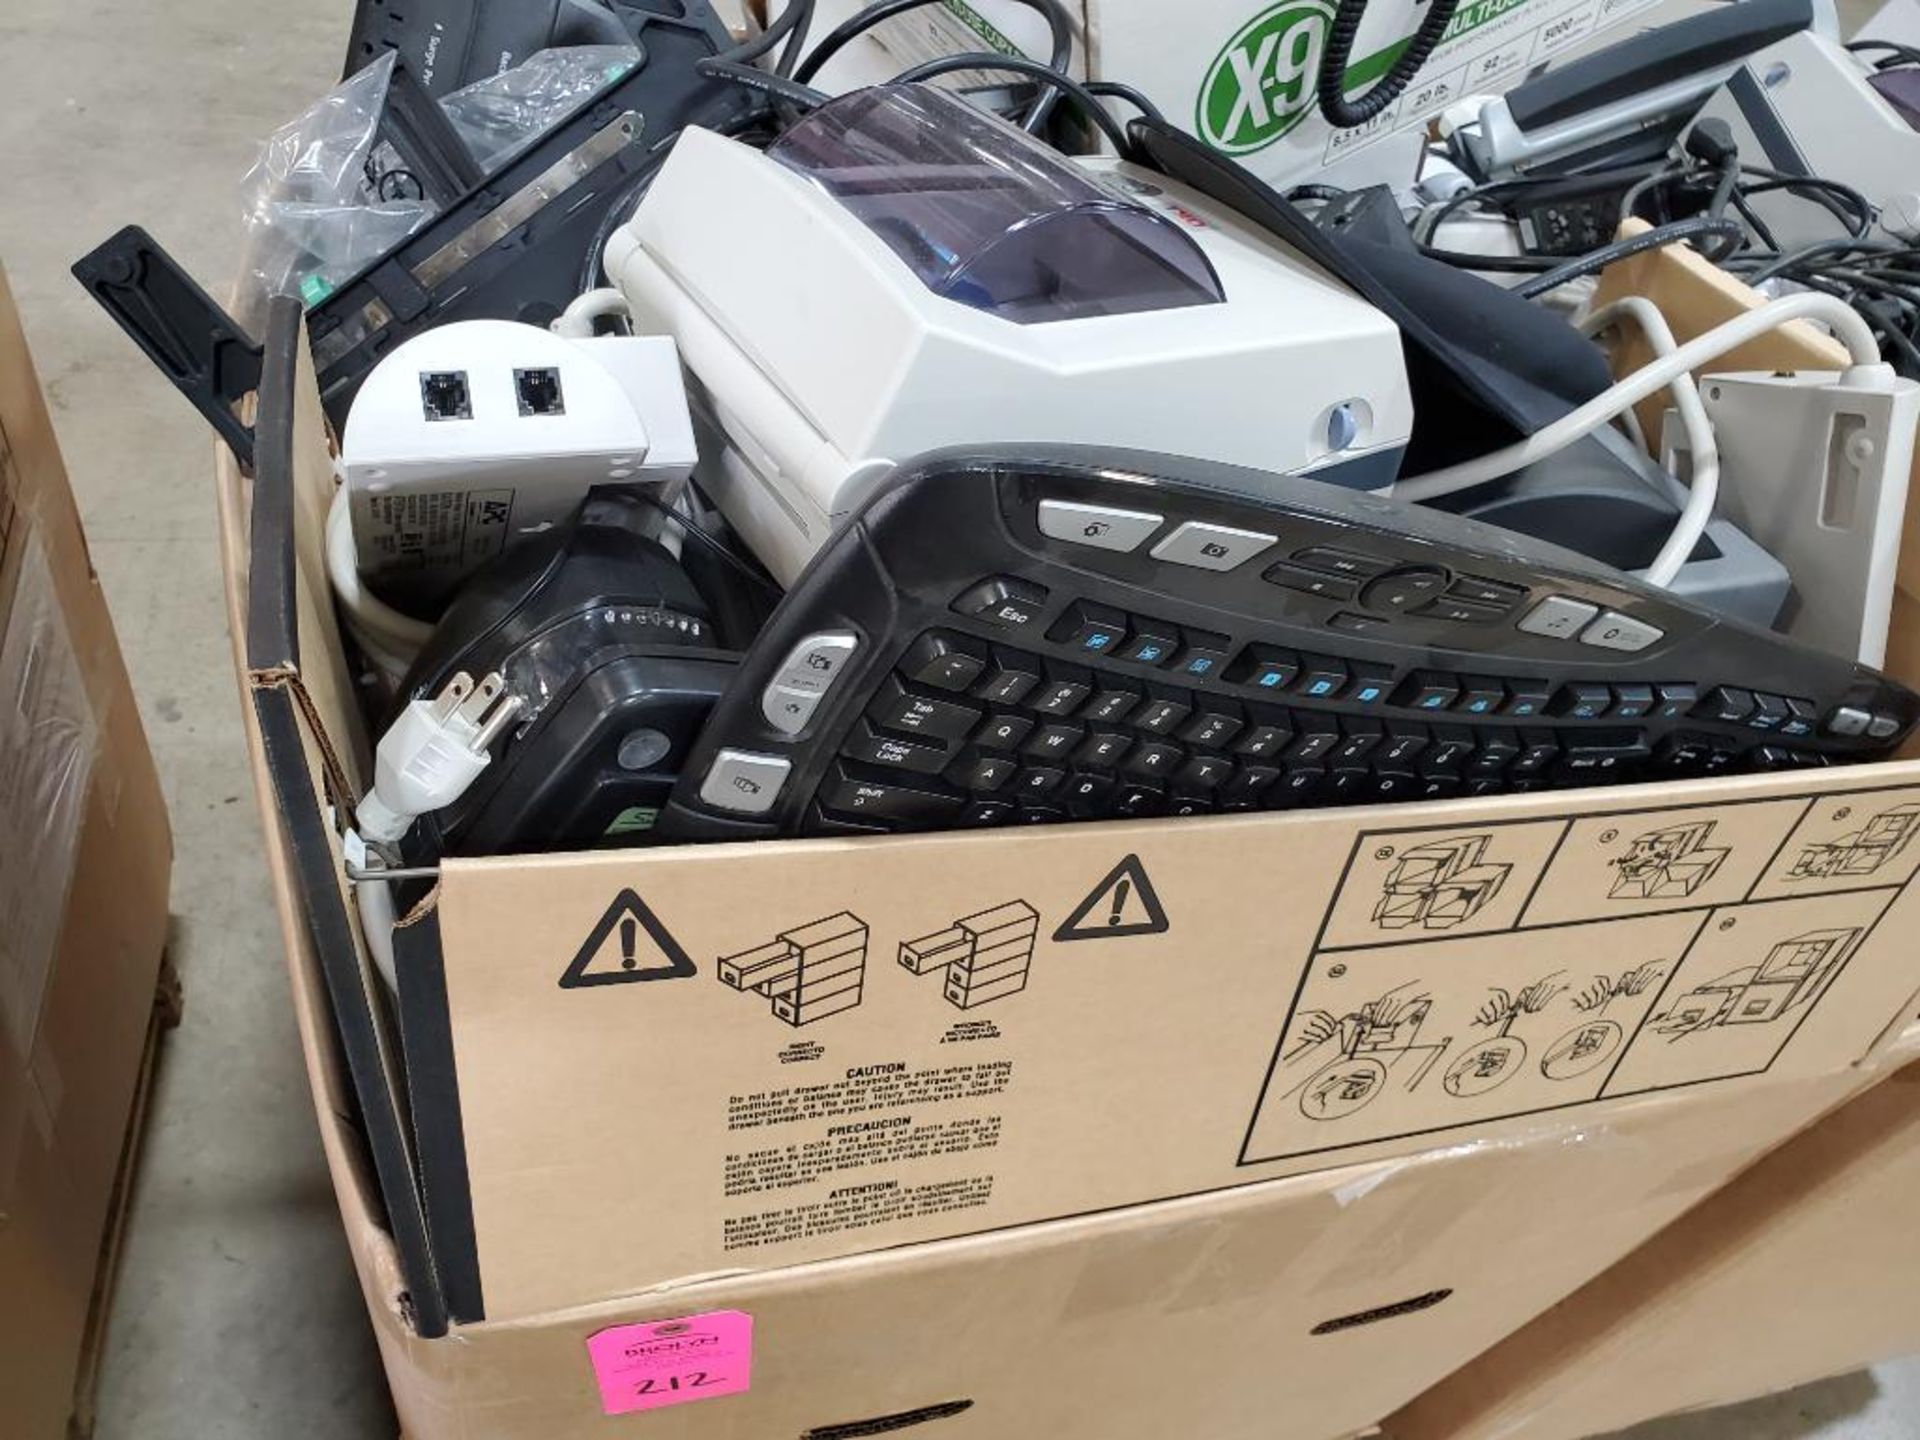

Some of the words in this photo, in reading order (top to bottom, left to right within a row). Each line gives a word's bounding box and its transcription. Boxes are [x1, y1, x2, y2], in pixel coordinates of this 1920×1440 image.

[424, 35, 441, 67] Surge
[1219, 15, 1325, 143] X-9
[998, 606, 1028, 625] Esc
[913, 701, 934, 713] Tab
[998, 725, 1012, 738] Q
[1047, 735, 1065, 747] W
[881, 743, 912, 755] Caps
[1097, 743, 1112, 754] E
[875, 750, 903, 762] Lock
[1145, 753, 1161, 765] R
[981, 768, 994, 778] A
[1200, 765, 1212, 777] T
[1031, 776, 1044, 786] S
[1248, 775, 1261, 786] Y
[1292, 776, 1305, 787] U
[856, 787, 885, 798] Shift
[1080, 783, 1093, 793] D
[1426, 784, 1439, 793] P
[846, 1061, 906, 1080] CAUTION
[855, 1076, 891, 1087] beyond
[895, 1072, 911, 1081] the
[904, 1080, 919, 1089] the
[924, 1076, 957, 1086] drawer
[829, 1179, 898, 1199] ATTENTION!
[632, 1372, 728, 1395] 212
